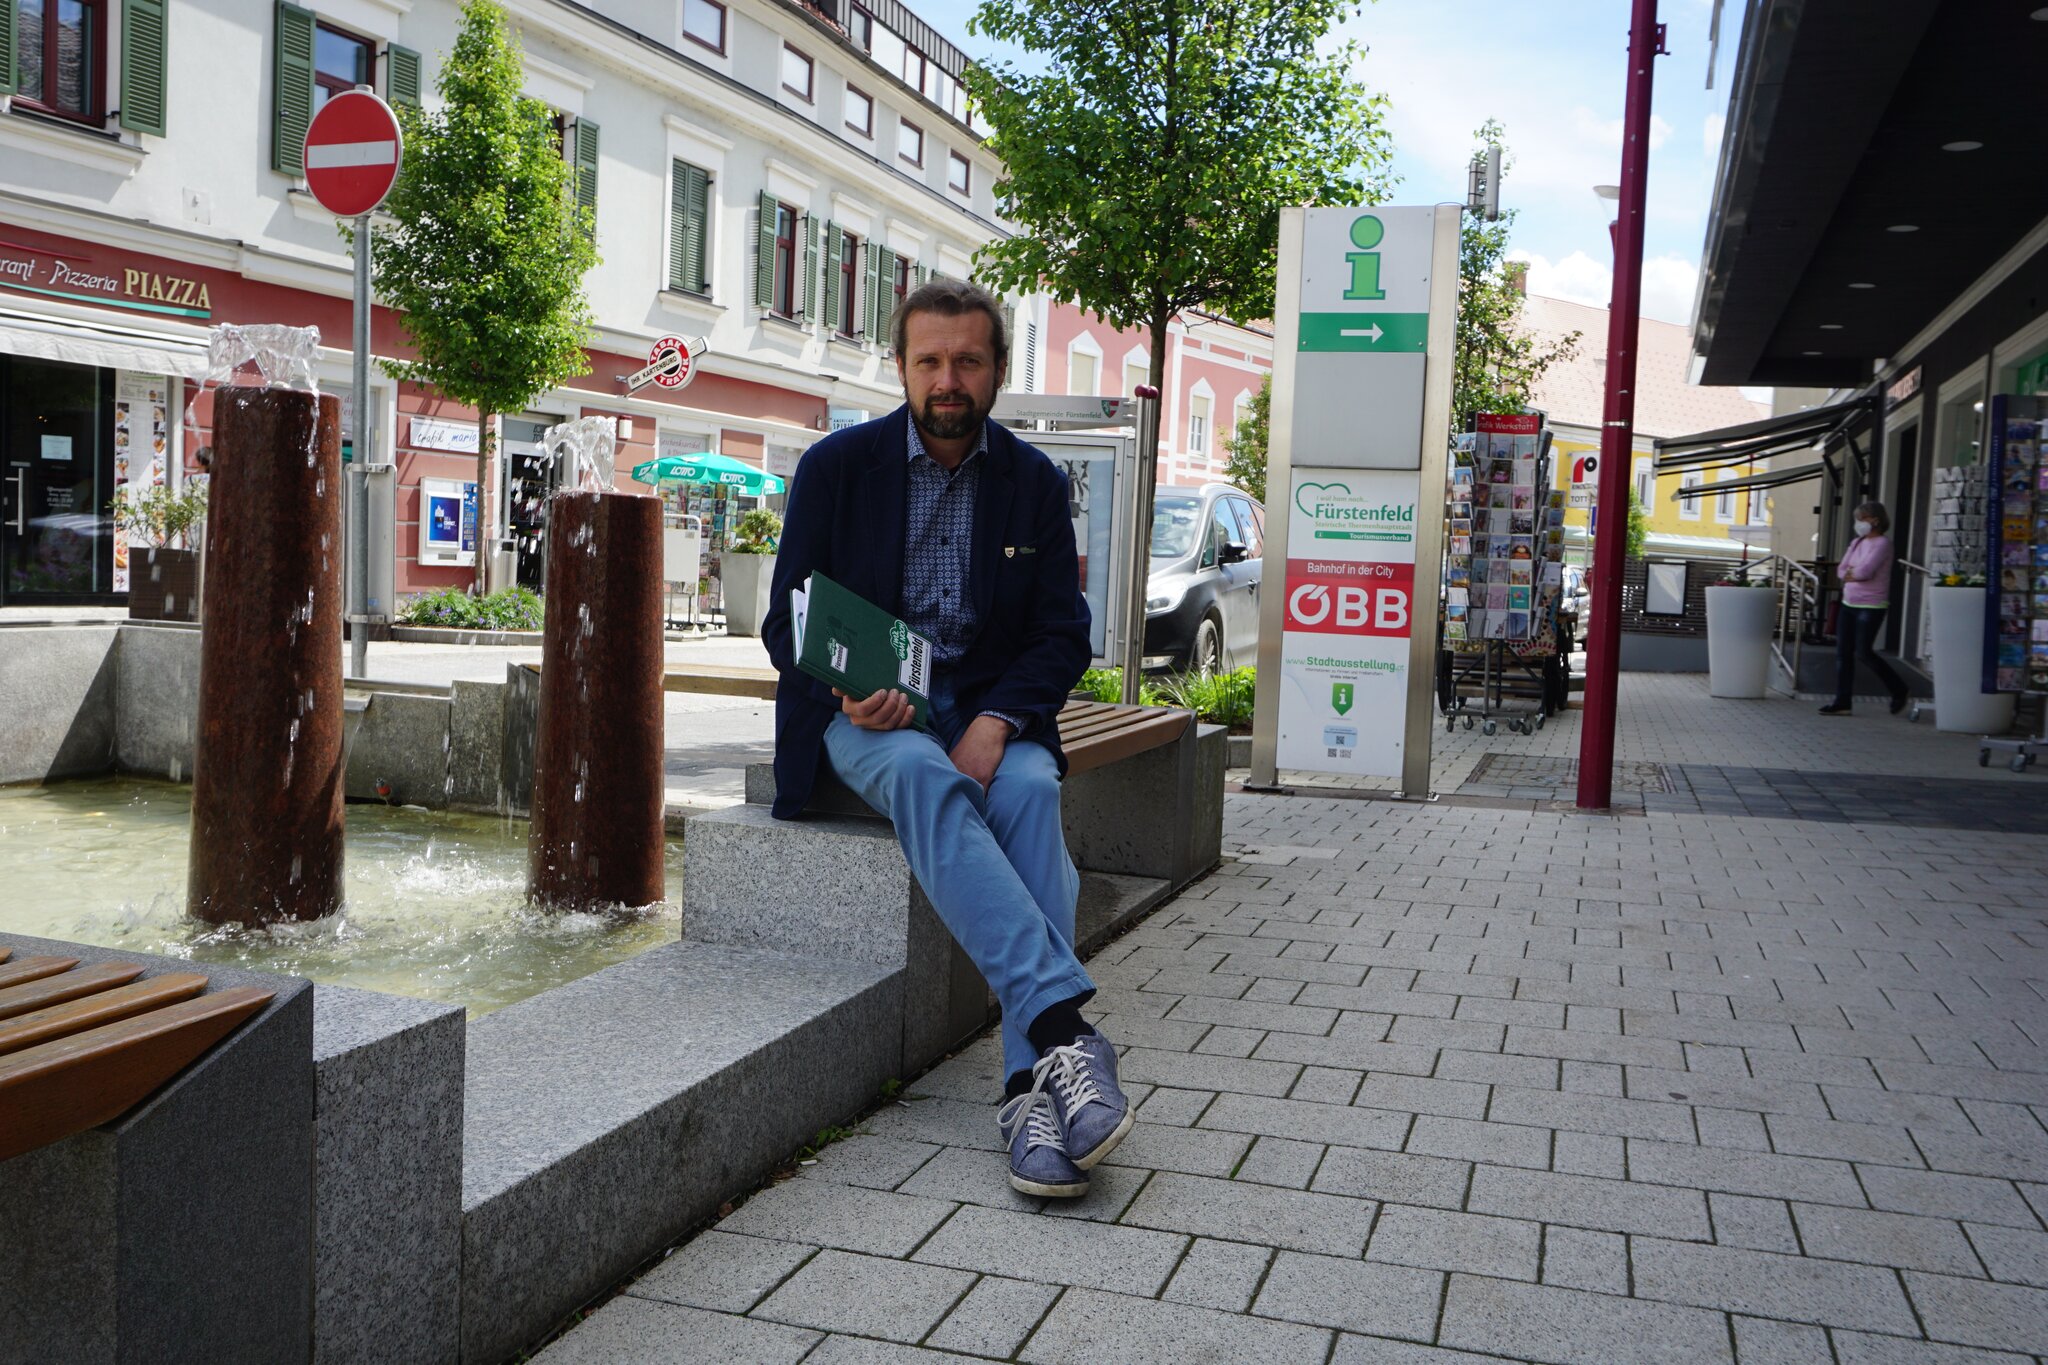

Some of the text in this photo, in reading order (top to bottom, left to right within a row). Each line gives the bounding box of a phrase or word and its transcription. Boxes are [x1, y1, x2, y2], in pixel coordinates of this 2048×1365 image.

[0, 259, 36, 281] rant
[49, 260, 118, 292] Pizzeria
[124, 268, 212, 309] PIAZZA
[650, 338, 682, 361] TABAK
[630, 355, 678, 385] IHR KARTENBÜRO
[660, 357, 689, 385] TRAFIK
[1016, 410, 1102, 419] Stadtgemeinde Fürstenfeld
[1495, 422, 1534, 430] Werkstatt
[451, 433, 477, 441] mario
[670, 465, 696, 477] LOTTO
[719, 471, 746, 484] LOTTO
[1315, 503, 1413, 521] Fürstenfeld
[1348, 522, 1412, 531] Thermenhauptstadt
[1349, 532, 1409, 541] Tourismusverband
[1307, 562, 1394, 578] Bahnhof in der City
[1289, 583, 1408, 630] ÖBB
[908, 636, 924, 691] Fürstenfeld
